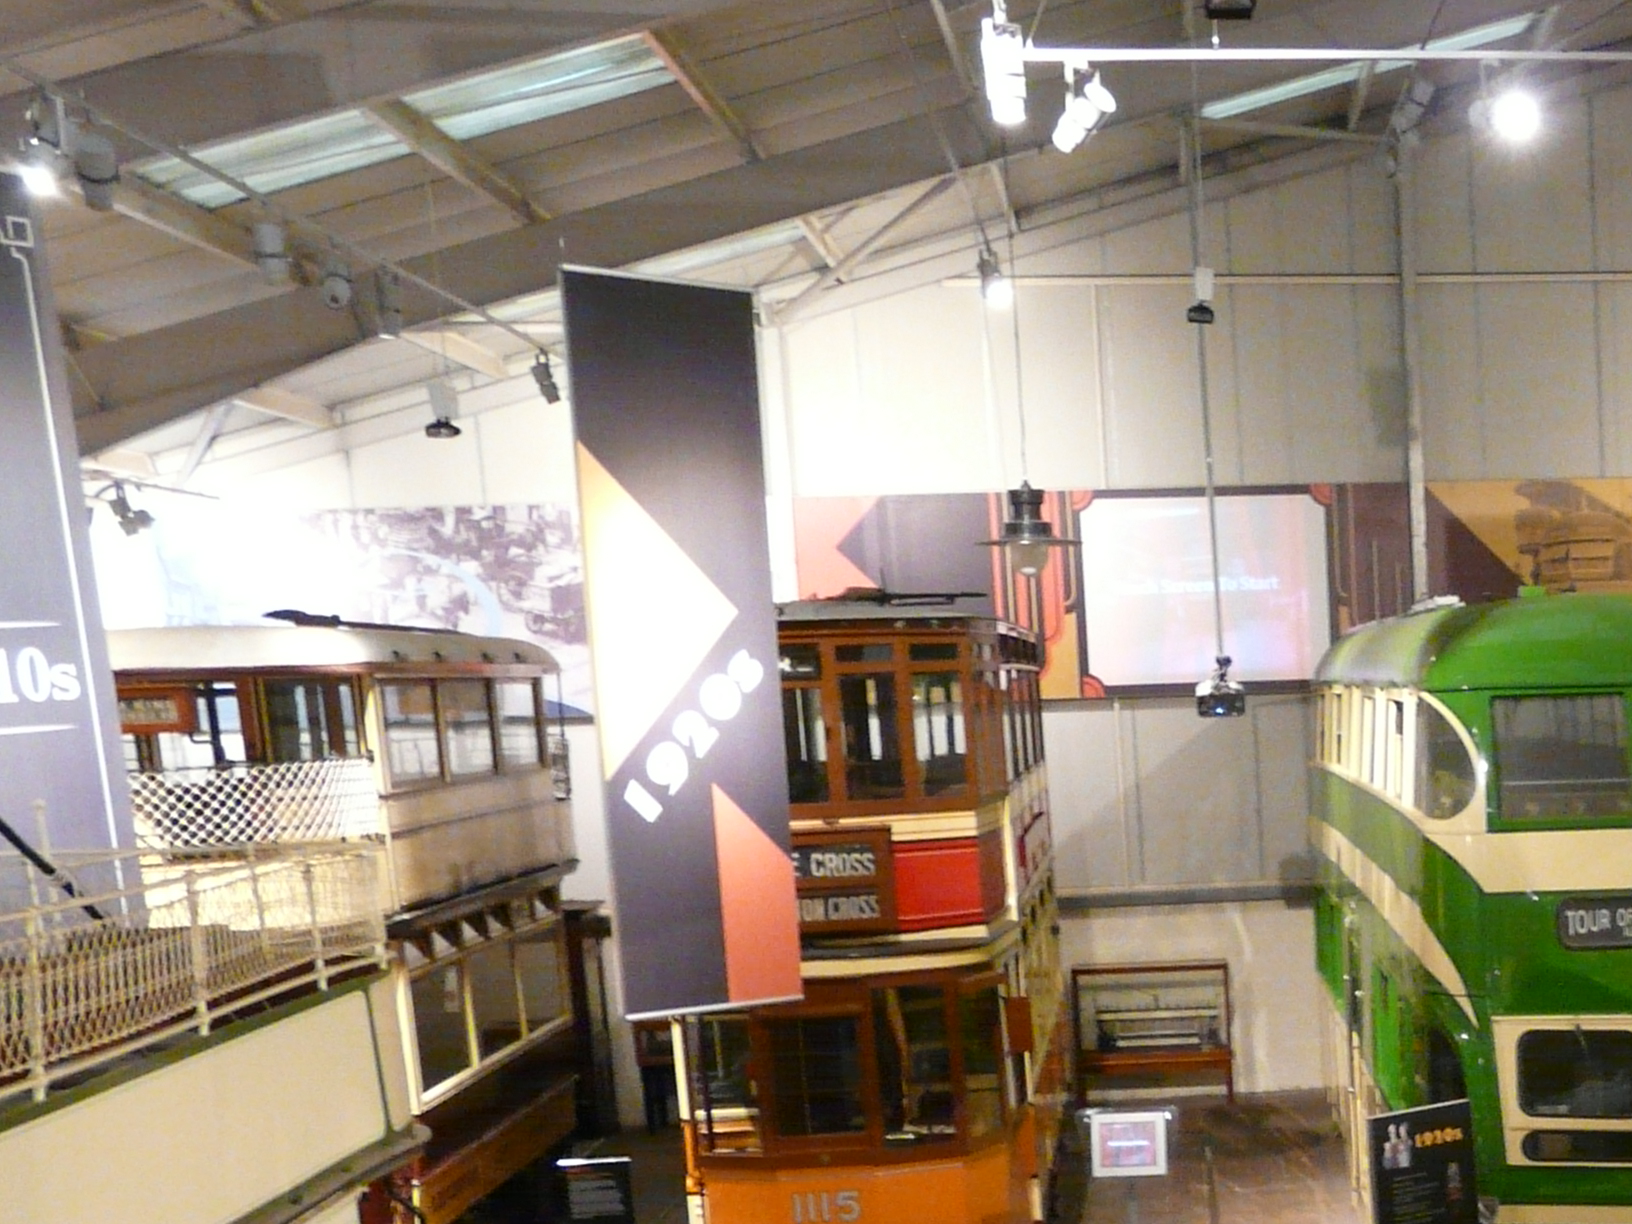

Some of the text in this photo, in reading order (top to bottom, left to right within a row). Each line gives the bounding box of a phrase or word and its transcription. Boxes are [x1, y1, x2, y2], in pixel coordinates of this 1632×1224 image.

[623, 649, 764, 823] 1920s
[810, 853, 876, 876] CROSS
[828, 895, 881, 920] CROSS
[1565, 909, 1612, 936] TOUR
[791, 1190, 861, 1224] 1115
